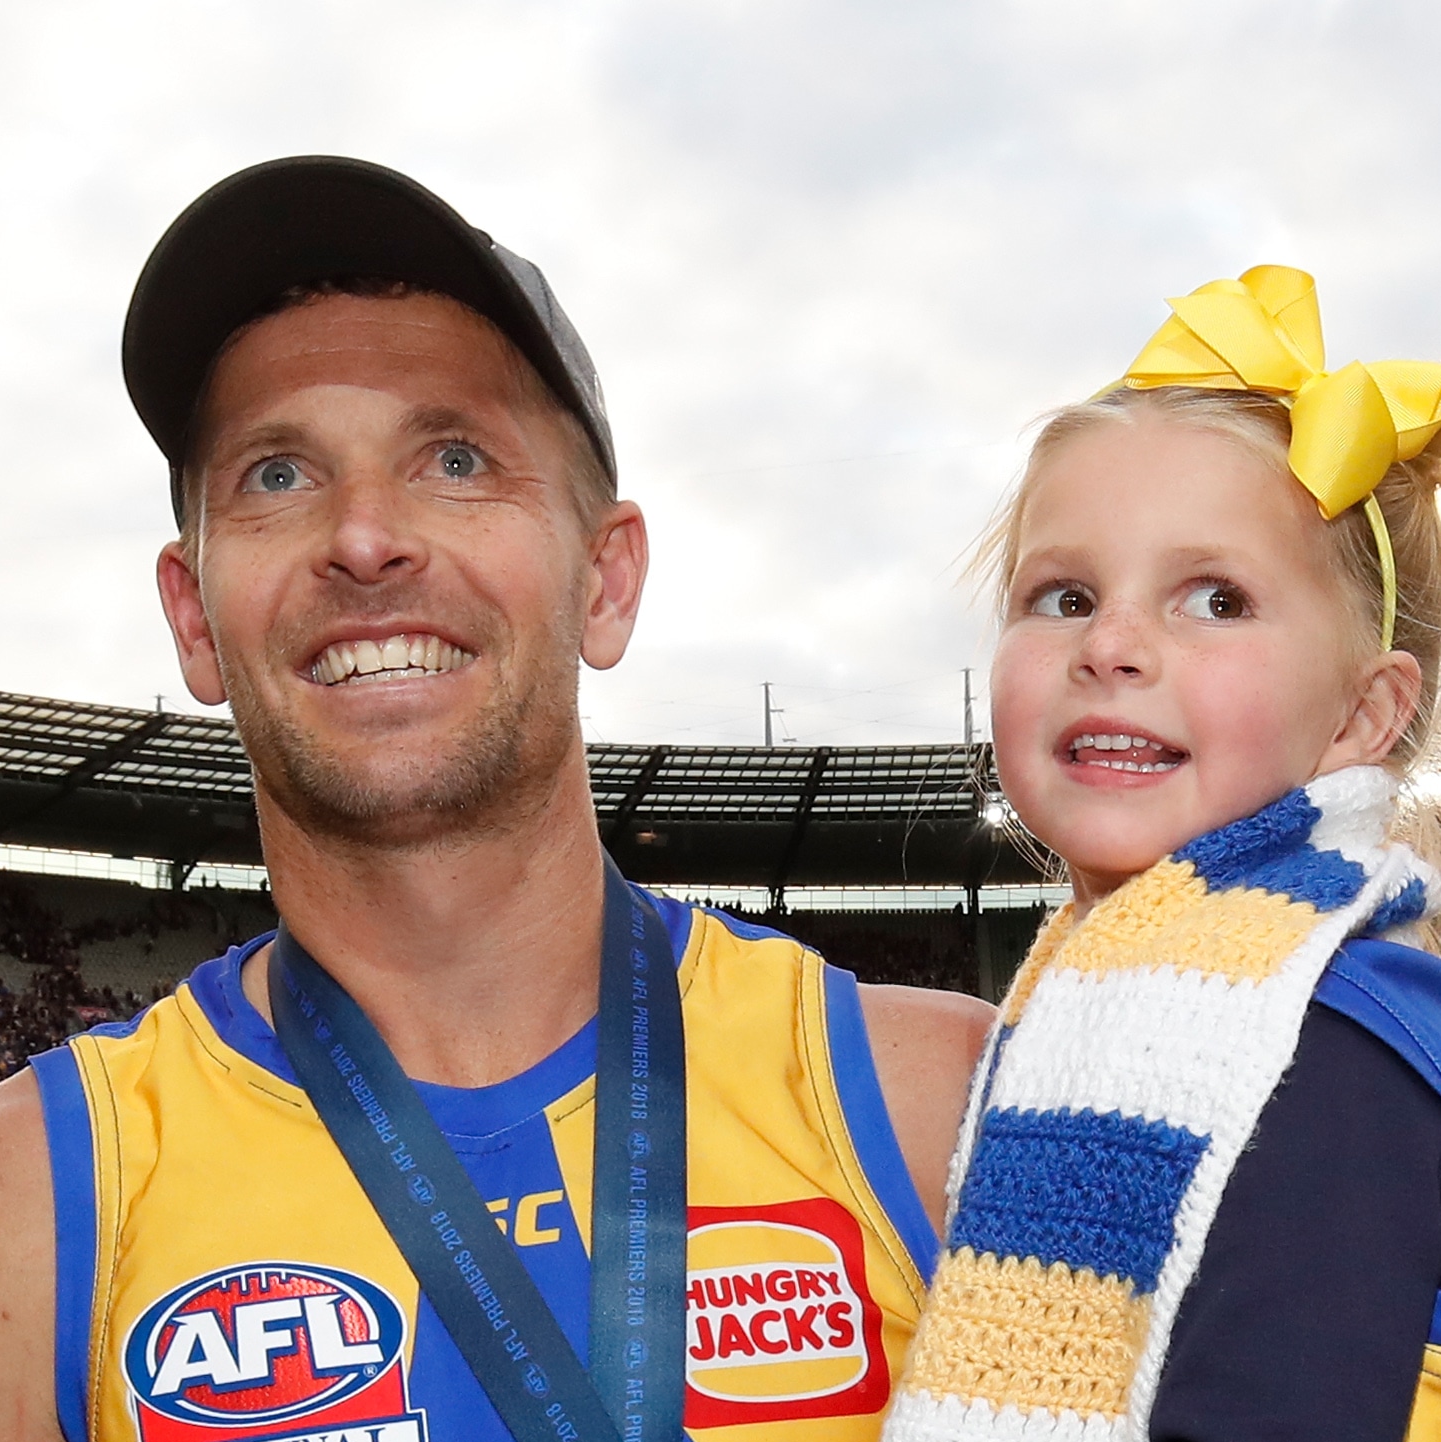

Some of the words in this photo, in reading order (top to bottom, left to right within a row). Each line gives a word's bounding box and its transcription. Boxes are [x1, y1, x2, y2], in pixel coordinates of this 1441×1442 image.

[632, 975, 648, 1002] AFL
[330, 1043, 357, 1078] 2018
[632, 1006, 649, 1079] PREMIERS
[347, 1073, 398, 1144] PREMIERS
[631, 1084, 648, 1120] 2018
[391, 1141, 417, 1172] AFL
[629, 1165, 647, 1194] AFL
[430, 1210, 463, 1251] 2018
[628, 1199, 647, 1282] PREMIERS
[454, 1250, 510, 1332] PREMIERS
[686, 1270, 842, 1310] HUNGRY
[150, 1293, 384, 1397] AFL
[504, 1328, 530, 1362] AFL
[689, 1301, 855, 1361] JACK'S
[625, 1378, 643, 1411] AFL
